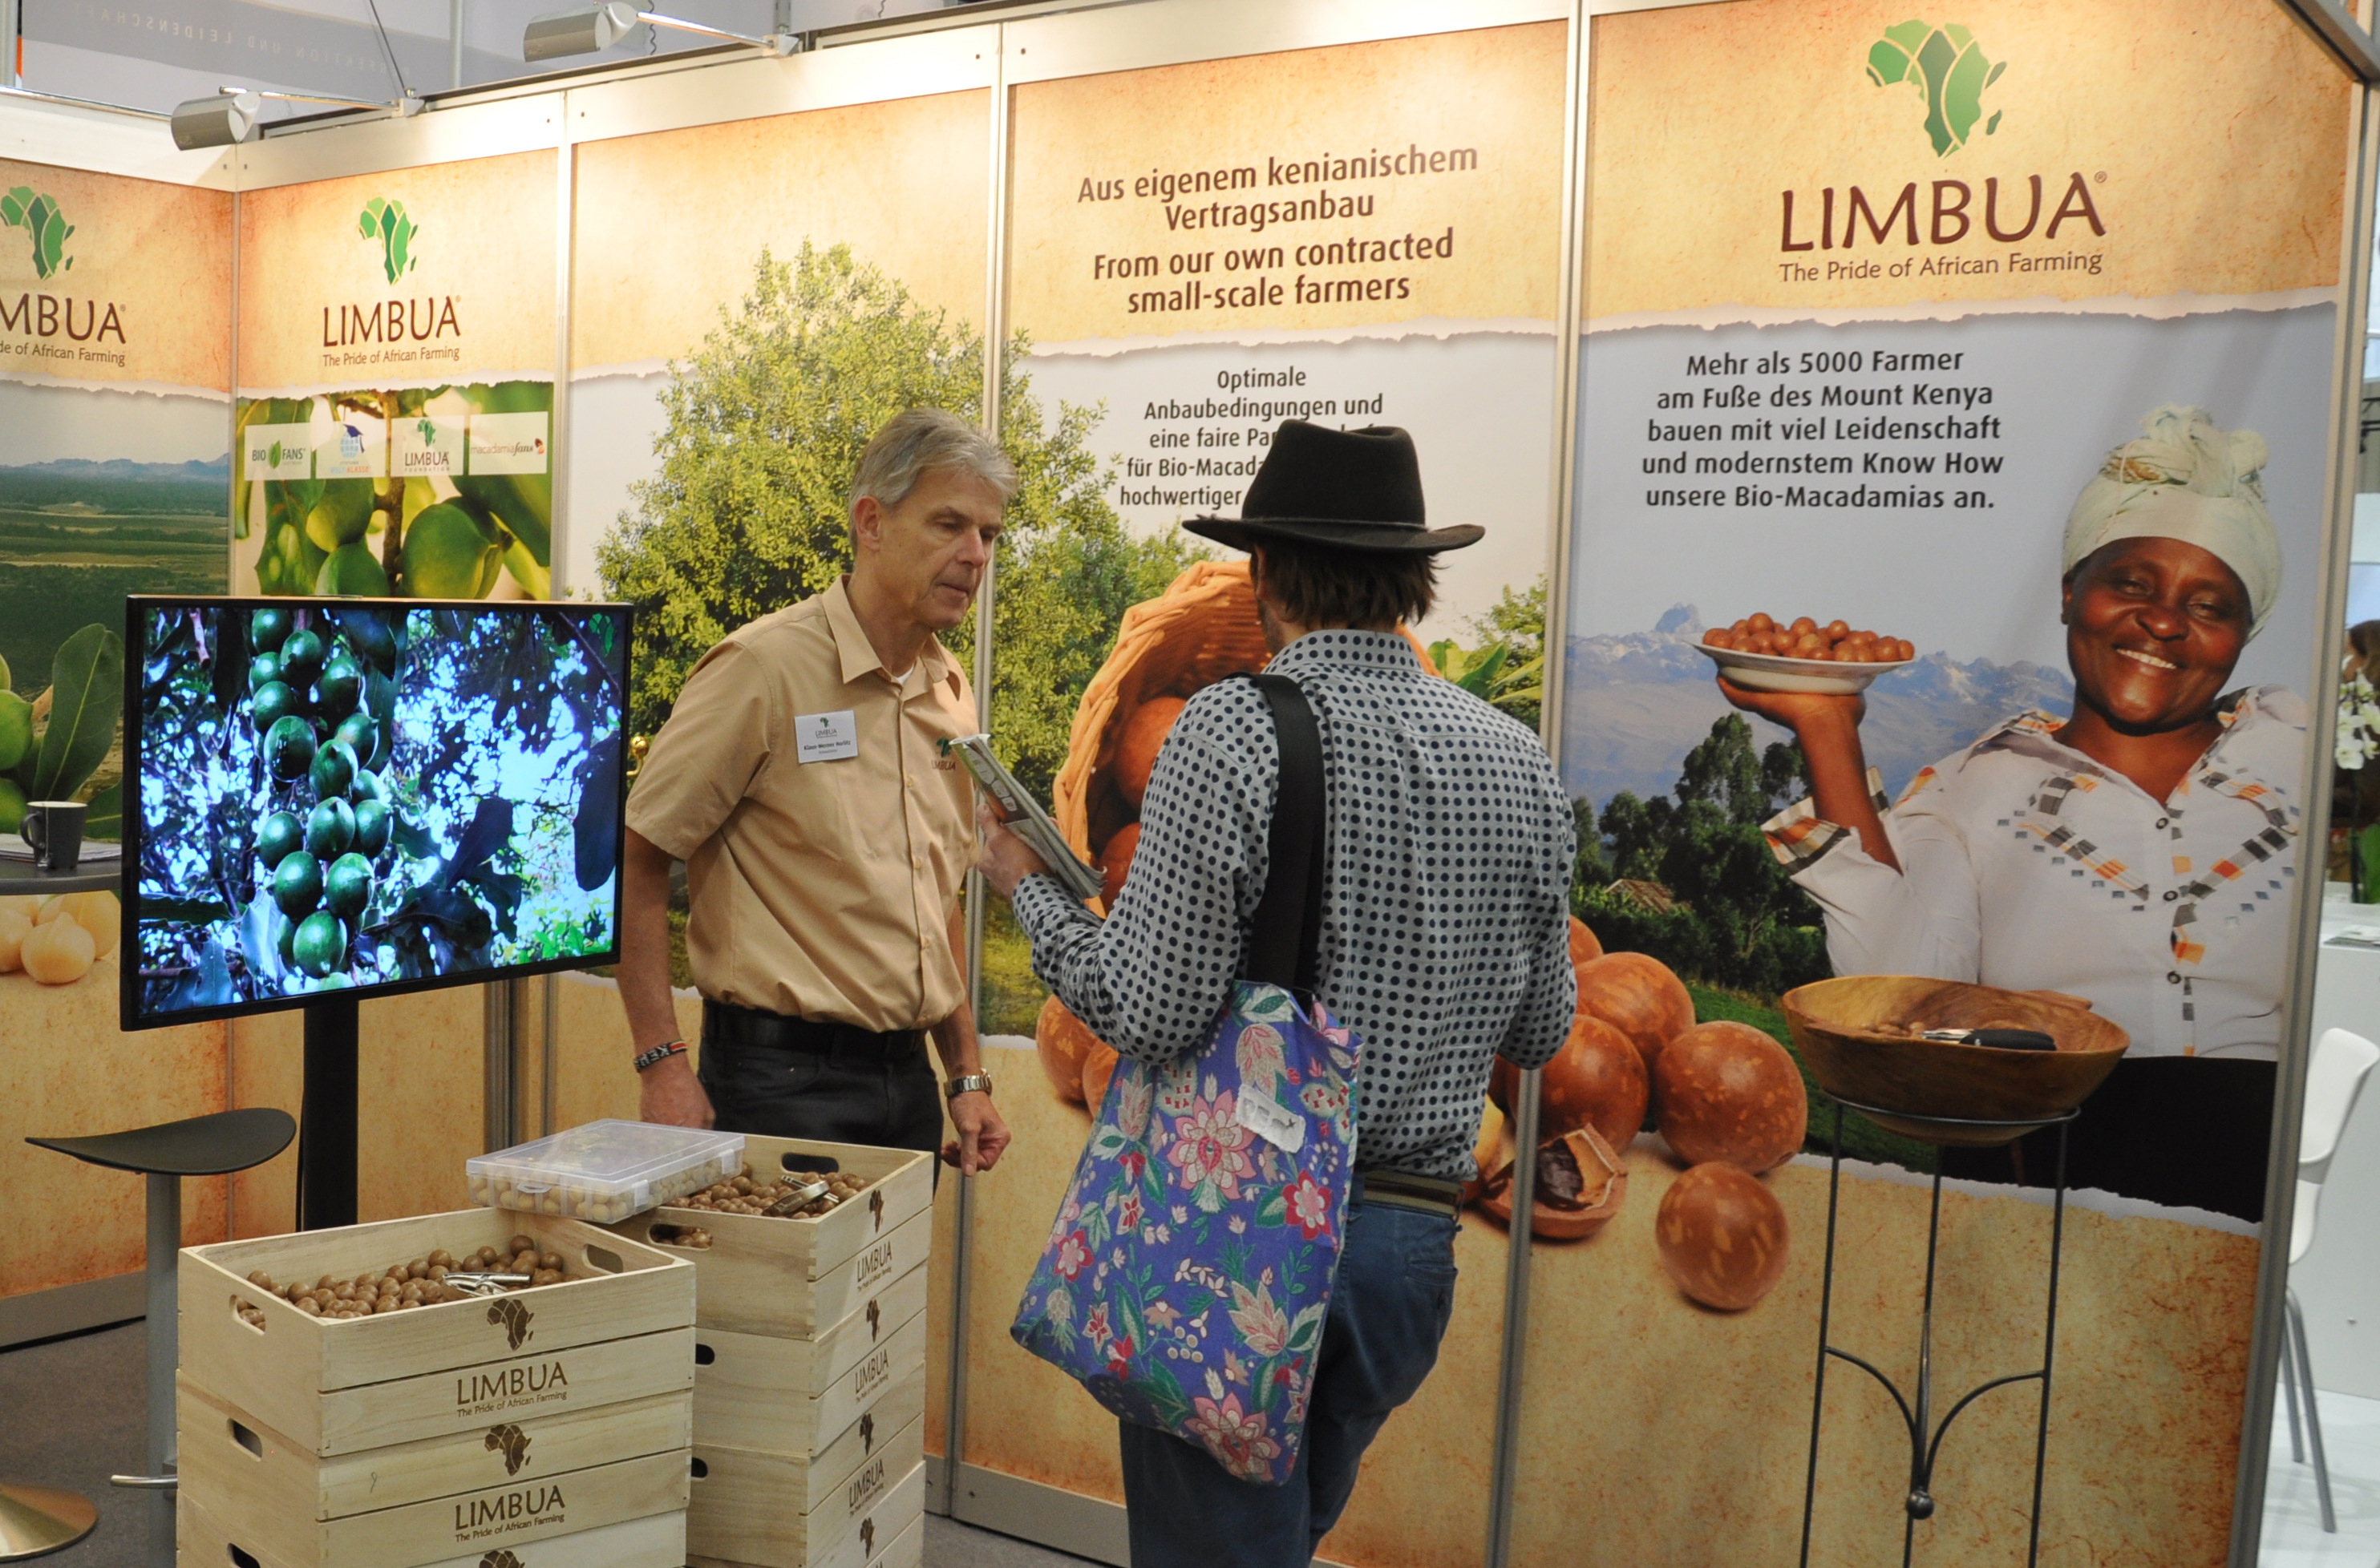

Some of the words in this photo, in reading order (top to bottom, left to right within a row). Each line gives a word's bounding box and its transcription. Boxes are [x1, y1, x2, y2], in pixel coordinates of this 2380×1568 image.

[1077, 176, 1124, 204] Aus
[1134, 167, 1257, 202] eigenem
[1268, 143, 1479, 187] kenianischem
[1164, 189, 1375, 232] Vertragsanbau
[1094, 253, 1160, 281] From
[1168, 250, 1214, 276] our
[1224, 246, 1284, 272] own
[1294, 227, 1454, 268] contracted
[1779, 261, 1819, 283] The
[1827, 257, 1881, 282] Pride
[1888, 256, 1915, 279] of
[1920, 254, 2000, 277] African
[2008, 250, 2103, 275] Farming
[1127, 276, 1284, 314] small-scale
[1294, 273, 1411, 305] farmers
[14, 342, 29, 355] of
[31, 343, 75, 360] African
[79, 347, 126, 368] Farming
[322, 354, 341, 367] The
[343, 351, 367, 366] Pride
[370, 350, 381, 363] of
[382, 348, 417, 362] African
[419, 346, 460, 362] Farming
[1686, 352, 1749, 377] Mehr
[1755, 350, 1791, 375] als
[1799, 351, 1863, 374] 5000
[1872, 350, 1964, 373] Farmer
[1216, 366, 1306, 394] Optimale
[1143, 396, 1338, 422] Anbaubedingungen
[1343, 393, 1383, 416] und
[1657, 390, 1695, 410] am
[1702, 385, 1761, 409] Fuße
[1769, 384, 1812, 408] des
[1821, 383, 1904, 407] Mount
[1912, 382, 1993, 411] Kenya
[1149, 426, 1191, 449] eine
[1196, 425, 1241, 447] faire
[1648, 418, 1722, 443] bauen
[1730, 418, 1773, 442] mit
[1780, 416, 1827, 441] viel
[1835, 414, 2002, 441] Leidenschaft
[251, 449, 267, 462] BIO
[1127, 456, 1153, 477] für
[1642, 451, 1686, 475] und
[1694, 450, 1853, 475] modernstem
[1863, 451, 1935, 475] Know
[1945, 451, 2005, 475] How
[1119, 484, 1243, 511] hochwertiger
[1645, 487, 1726, 508] unsere
[1734, 484, 1945, 509] Bio-Macadamias
[1953, 489, 1995, 509] an.
[856, 1240, 892, 1283] LIMBUA
[456, 1361, 568, 1405] LIMBUA
[855, 1348, 889, 1395] LIMBUA
[456, 1408, 473, 1418] The
[474, 1403, 495, 1414] Pride
[496, 1400, 505, 1410] of
[507, 1396, 535, 1408] African
[536, 1391, 568, 1403] Farming
[848, 1457, 884, 1508] LIMBUA
[455, 1485, 566, 1531] LIMBUA
[455, 1533, 471, 1542] The
[472, 1528, 492, 1539] Pride
[494, 1524, 504, 1534] of
[505, 1520, 532, 1532] African
[534, 1513, 565, 1526] Farming
